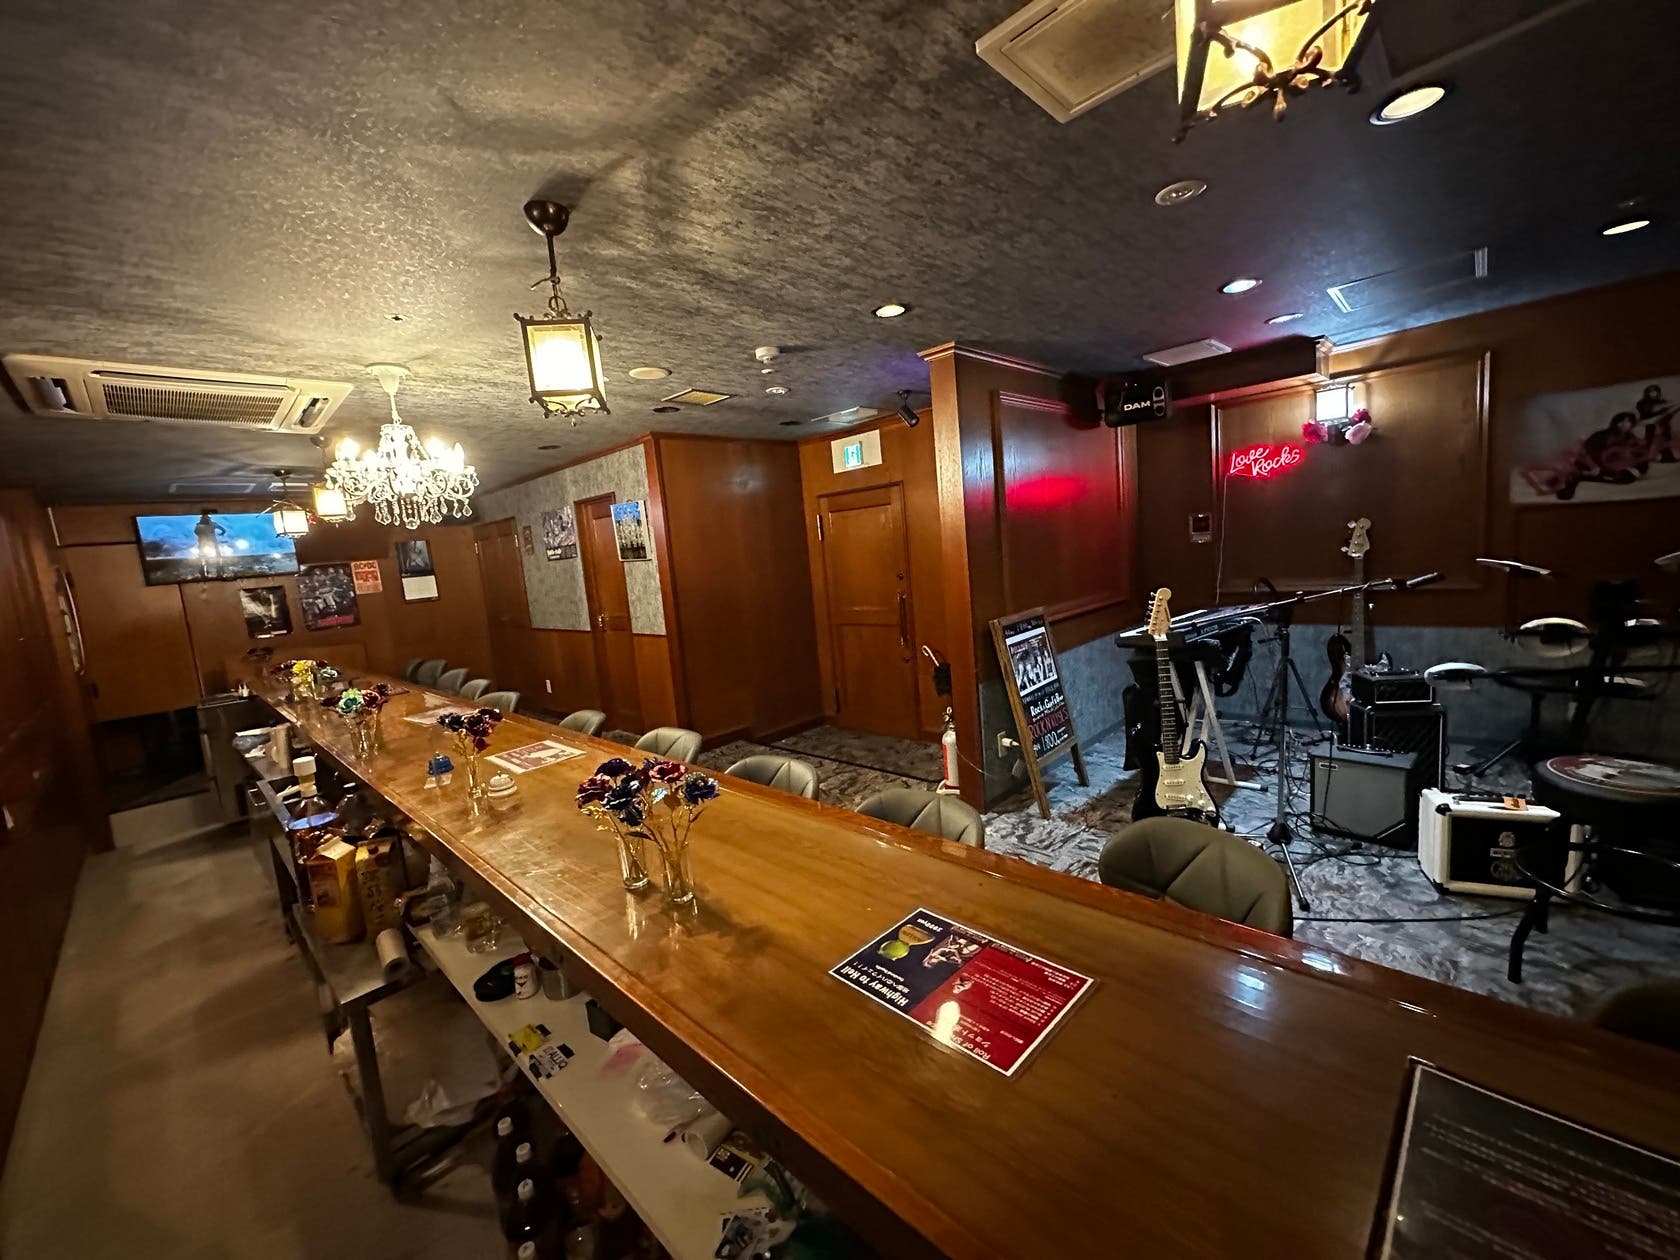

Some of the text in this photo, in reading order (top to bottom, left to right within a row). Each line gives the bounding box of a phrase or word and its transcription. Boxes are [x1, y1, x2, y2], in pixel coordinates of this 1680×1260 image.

[1123, 400, 1151, 411] DAM
[1229, 447, 1270, 474] Love
[1251, 445, 1301, 477] Rocks
[840, 966, 861, 980] Hell
[859, 975, 871, 984] to
[869, 981, 910, 1007] Highway
[973, 1047, 991, 1060] Roll
